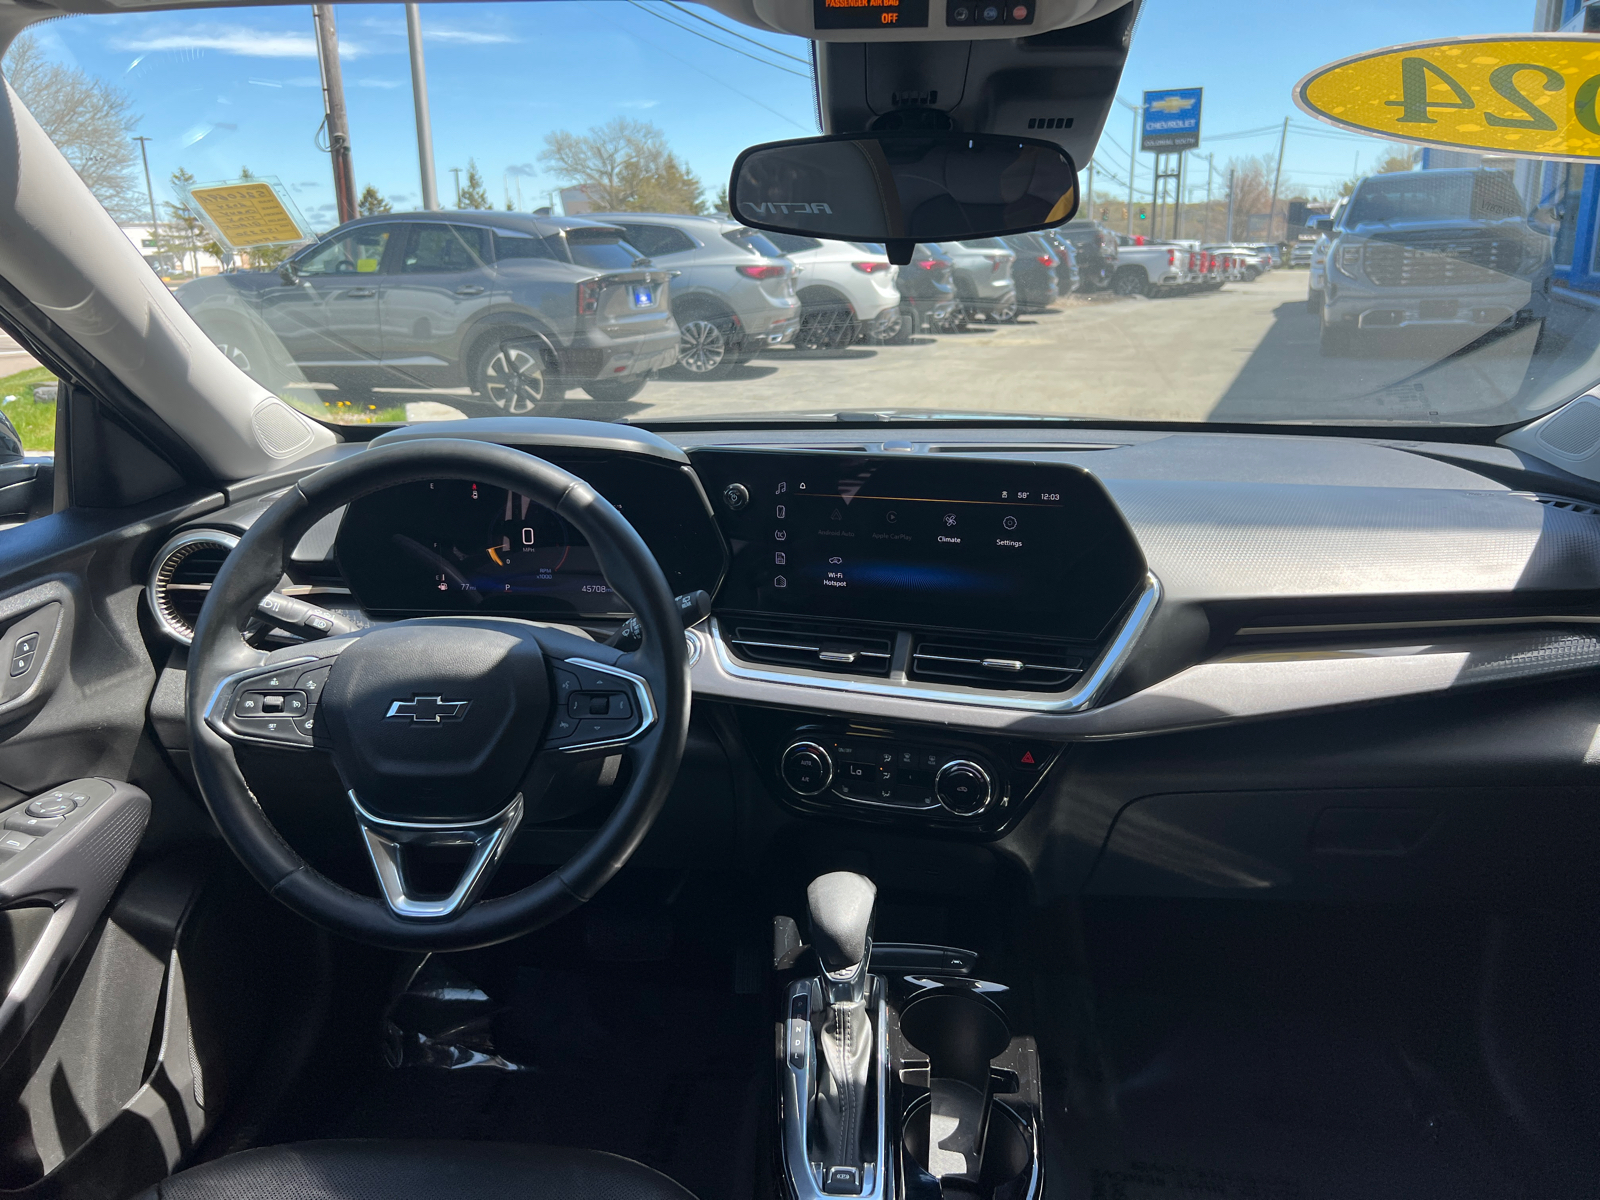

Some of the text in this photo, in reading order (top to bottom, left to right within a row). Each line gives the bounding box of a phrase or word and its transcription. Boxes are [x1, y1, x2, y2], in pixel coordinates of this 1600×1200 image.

[881, 13, 899, 24] OFF
[1146, 120, 1196, 130] CHEVROLET
[521, 527, 535, 545] 0
[817, 529, 840, 537] Android
[872, 532, 912, 541] Apple CarPlay
[937, 535, 961, 544] Climate
[996, 538, 1022, 548] Settings
[504, 583, 511, 591] P
[823, 579, 847, 588] Hotspot
